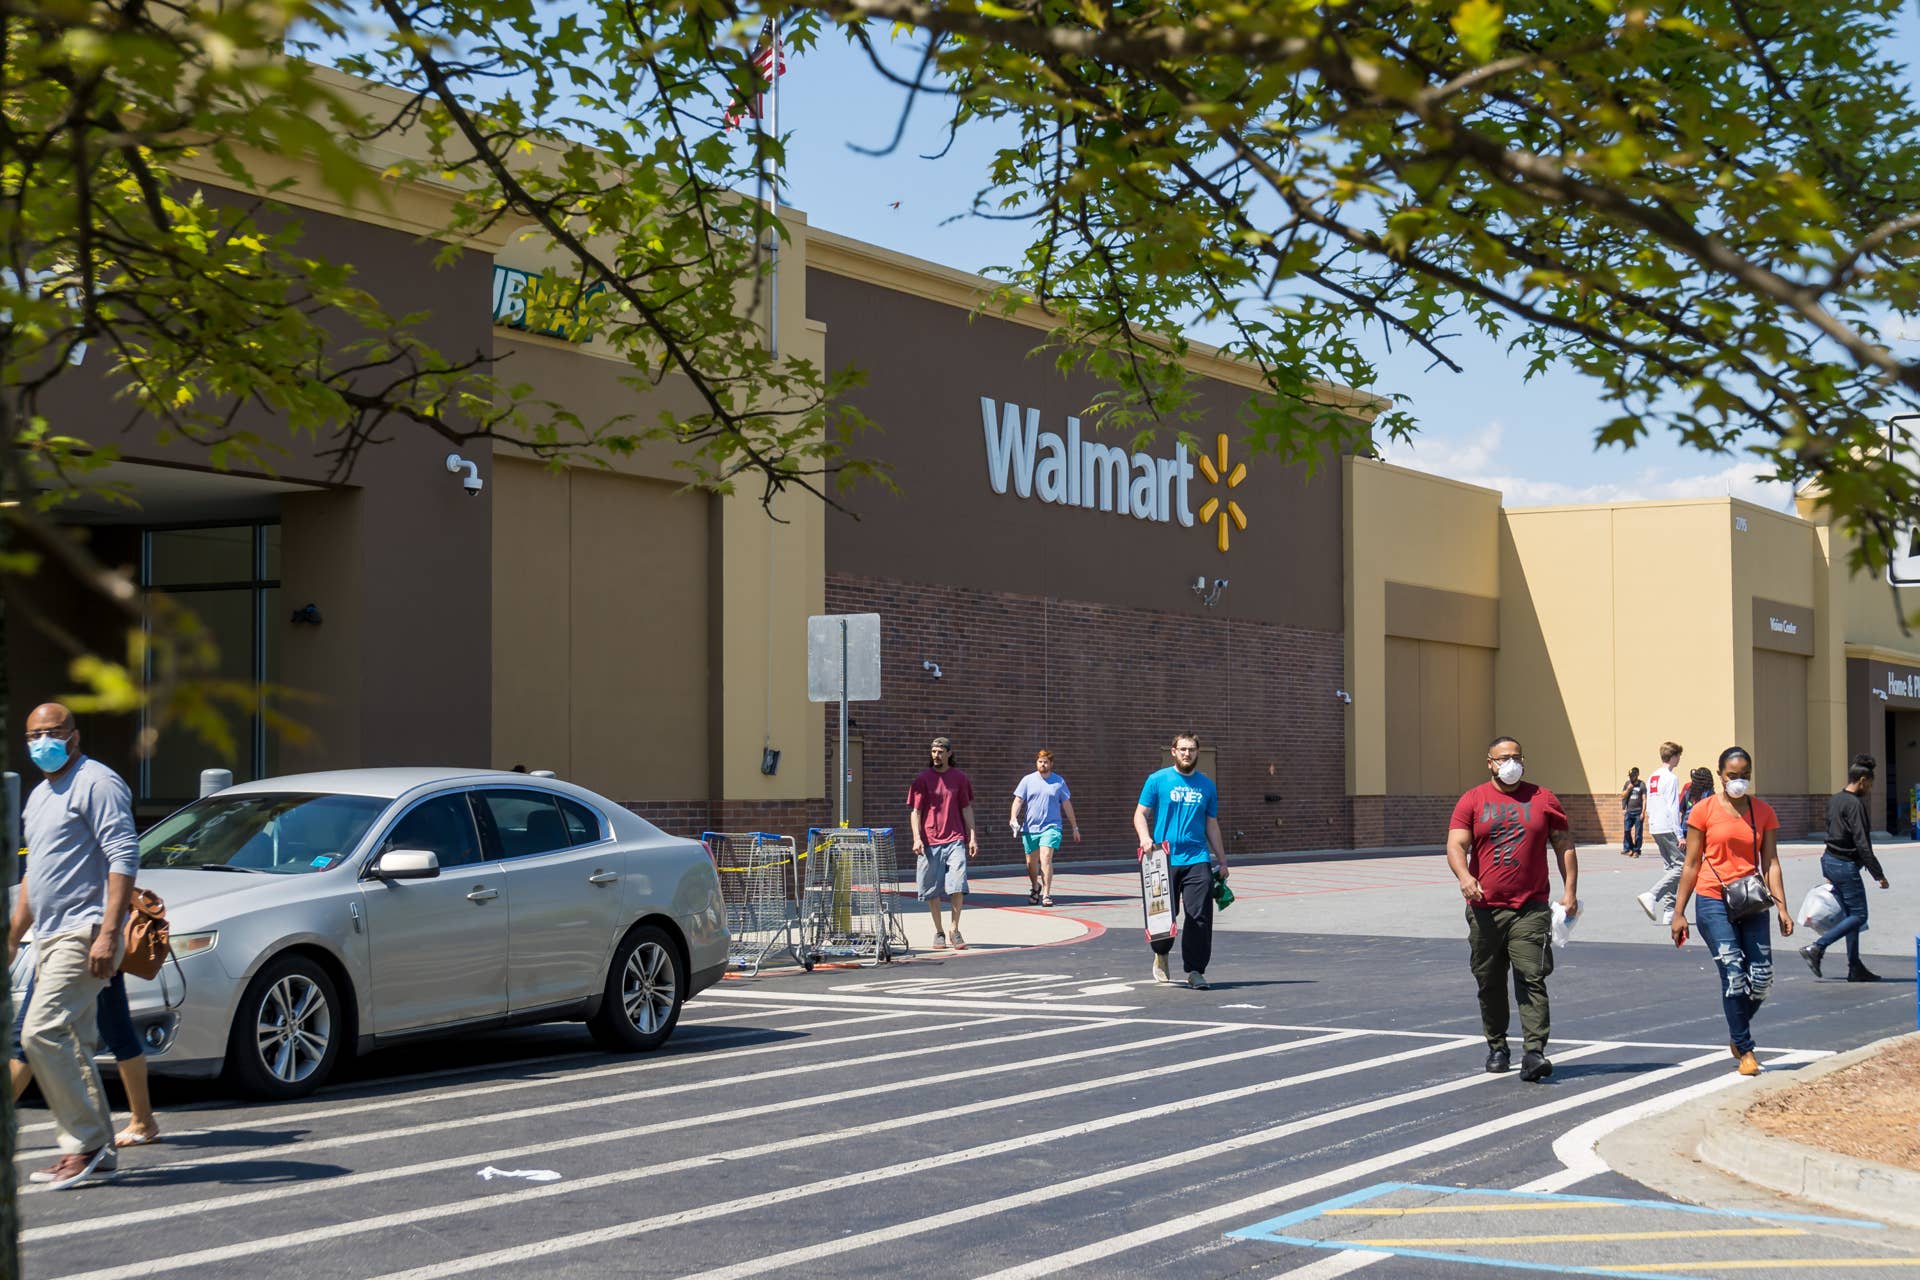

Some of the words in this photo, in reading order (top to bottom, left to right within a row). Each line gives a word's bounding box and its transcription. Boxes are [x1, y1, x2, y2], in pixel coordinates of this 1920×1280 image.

[981, 396, 1194, 527] Walmart
[1769, 616, 1783, 632] Vision
[1783, 620, 1797, 634] Center
[1888, 671, 1907, 697] Home
[1907, 674, 1913, 698] &
[1480, 802, 1532, 823] JUST
[1490, 823, 1525, 844] DO
